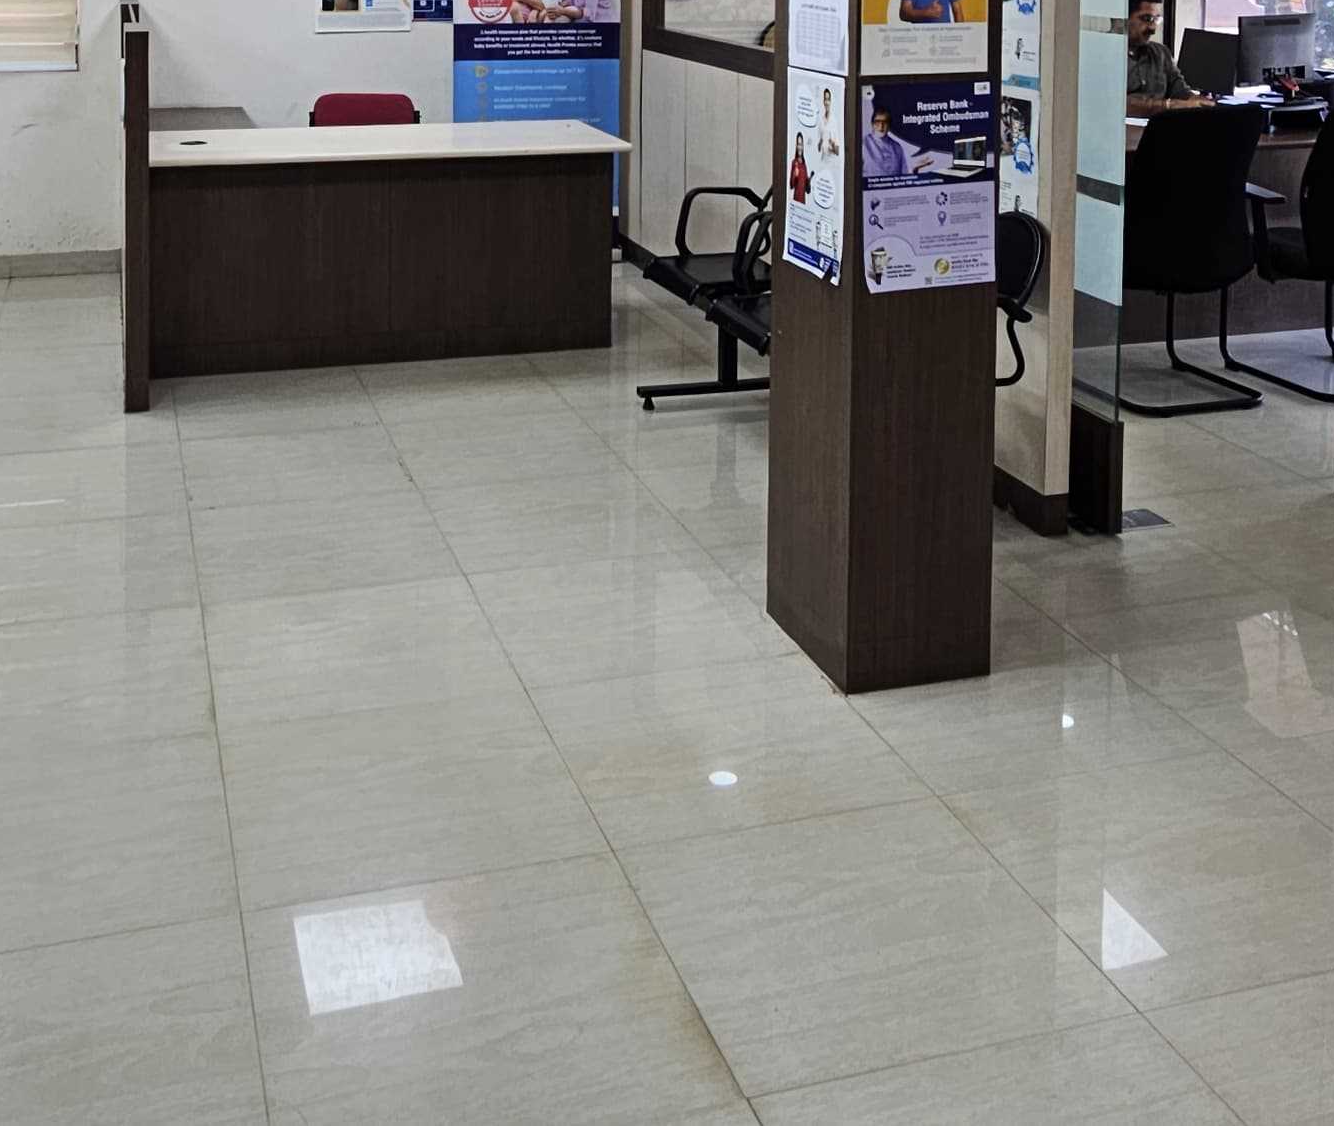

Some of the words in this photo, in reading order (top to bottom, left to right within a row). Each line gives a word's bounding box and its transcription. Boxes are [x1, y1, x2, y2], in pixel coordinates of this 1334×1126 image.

[917, 102, 948, 111] Reserve
[950, 99, 968, 109] Bank
[903, 113, 941, 125] Integrated
[942, 111, 989, 122] Ombudsman
[930, 124, 960, 134] Scheme
